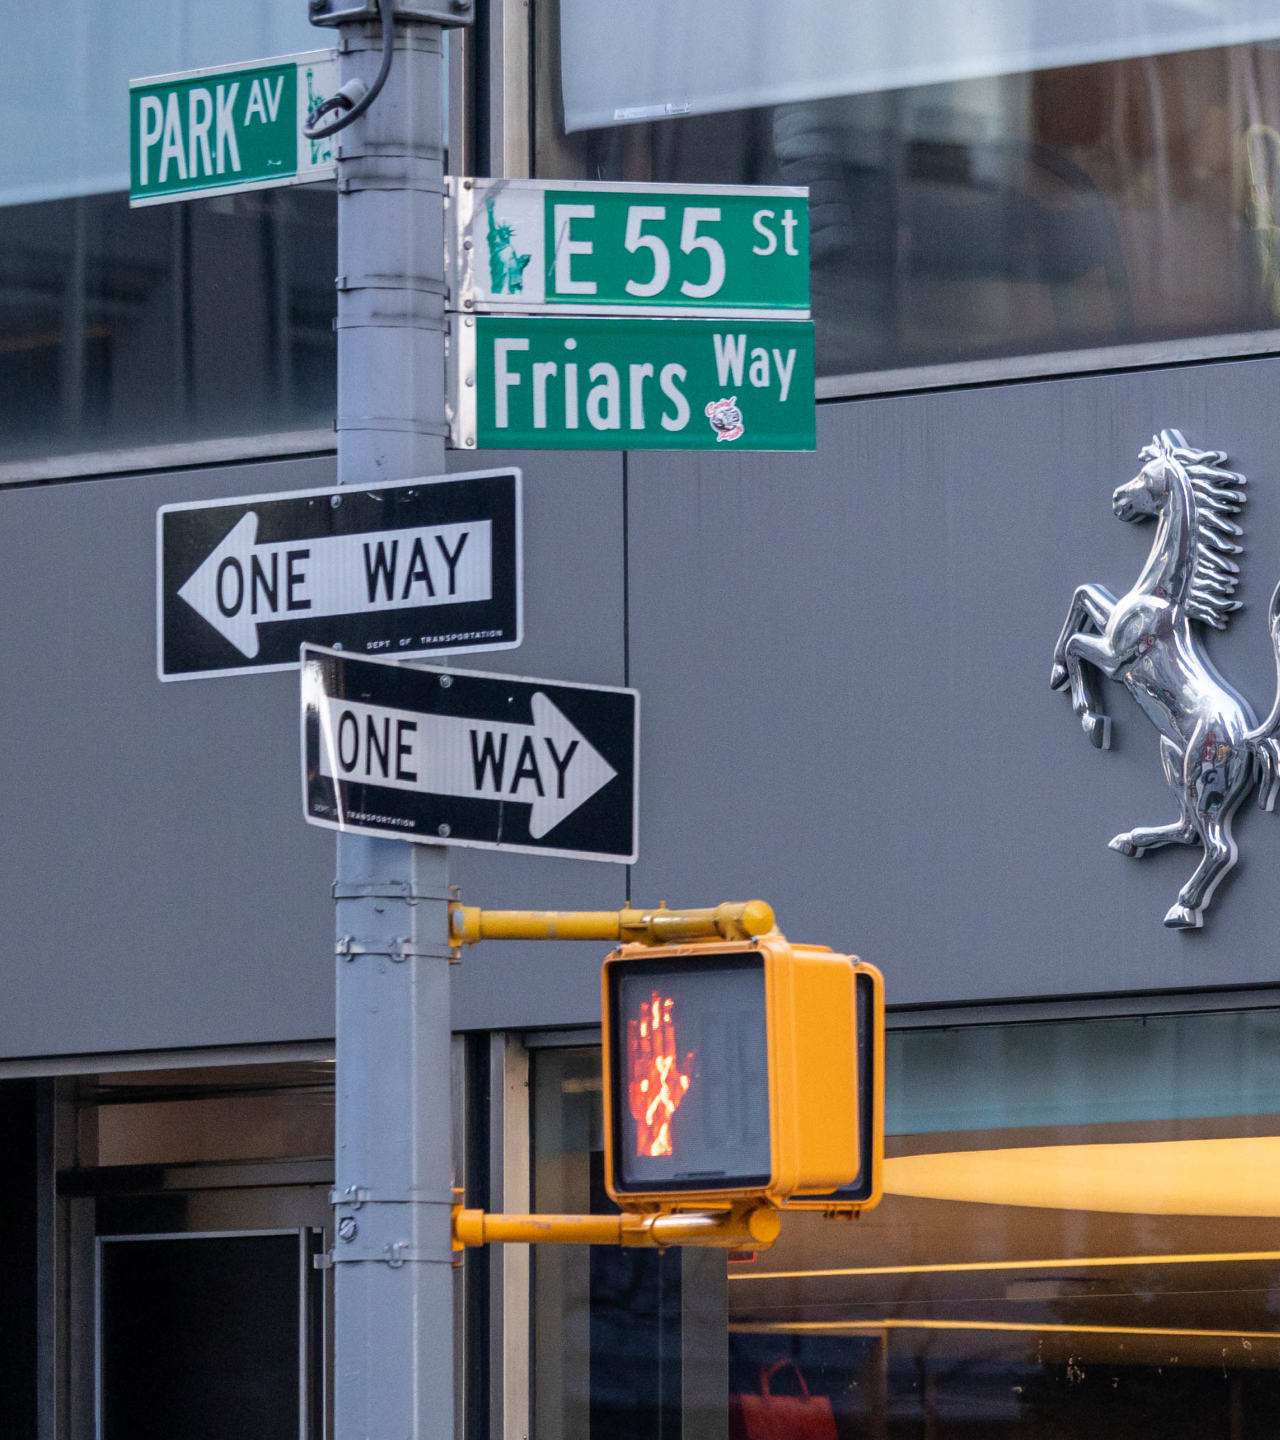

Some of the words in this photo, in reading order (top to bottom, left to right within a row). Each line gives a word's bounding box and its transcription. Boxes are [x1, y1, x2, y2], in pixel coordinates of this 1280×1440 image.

[140, 82, 242, 186] PARK
[243, 75, 285, 127] AV
[554, 203, 598, 295] E
[624, 205, 727, 299] 55
[752, 208, 800, 257] St
[494, 337, 691, 432] Friars
[713, 333, 797, 402] Way
[216, 549, 312, 618] ONE
[363, 532, 470, 603] WAY
[366, 640, 391, 650] DEPT
[399, 638, 412, 647] OF
[421, 630, 503, 644] TRANSPORTATION
[338, 710, 418, 783] ONE
[469, 729, 580, 799] WAY
[346, 811, 416, 827] TRANSPORTATION
